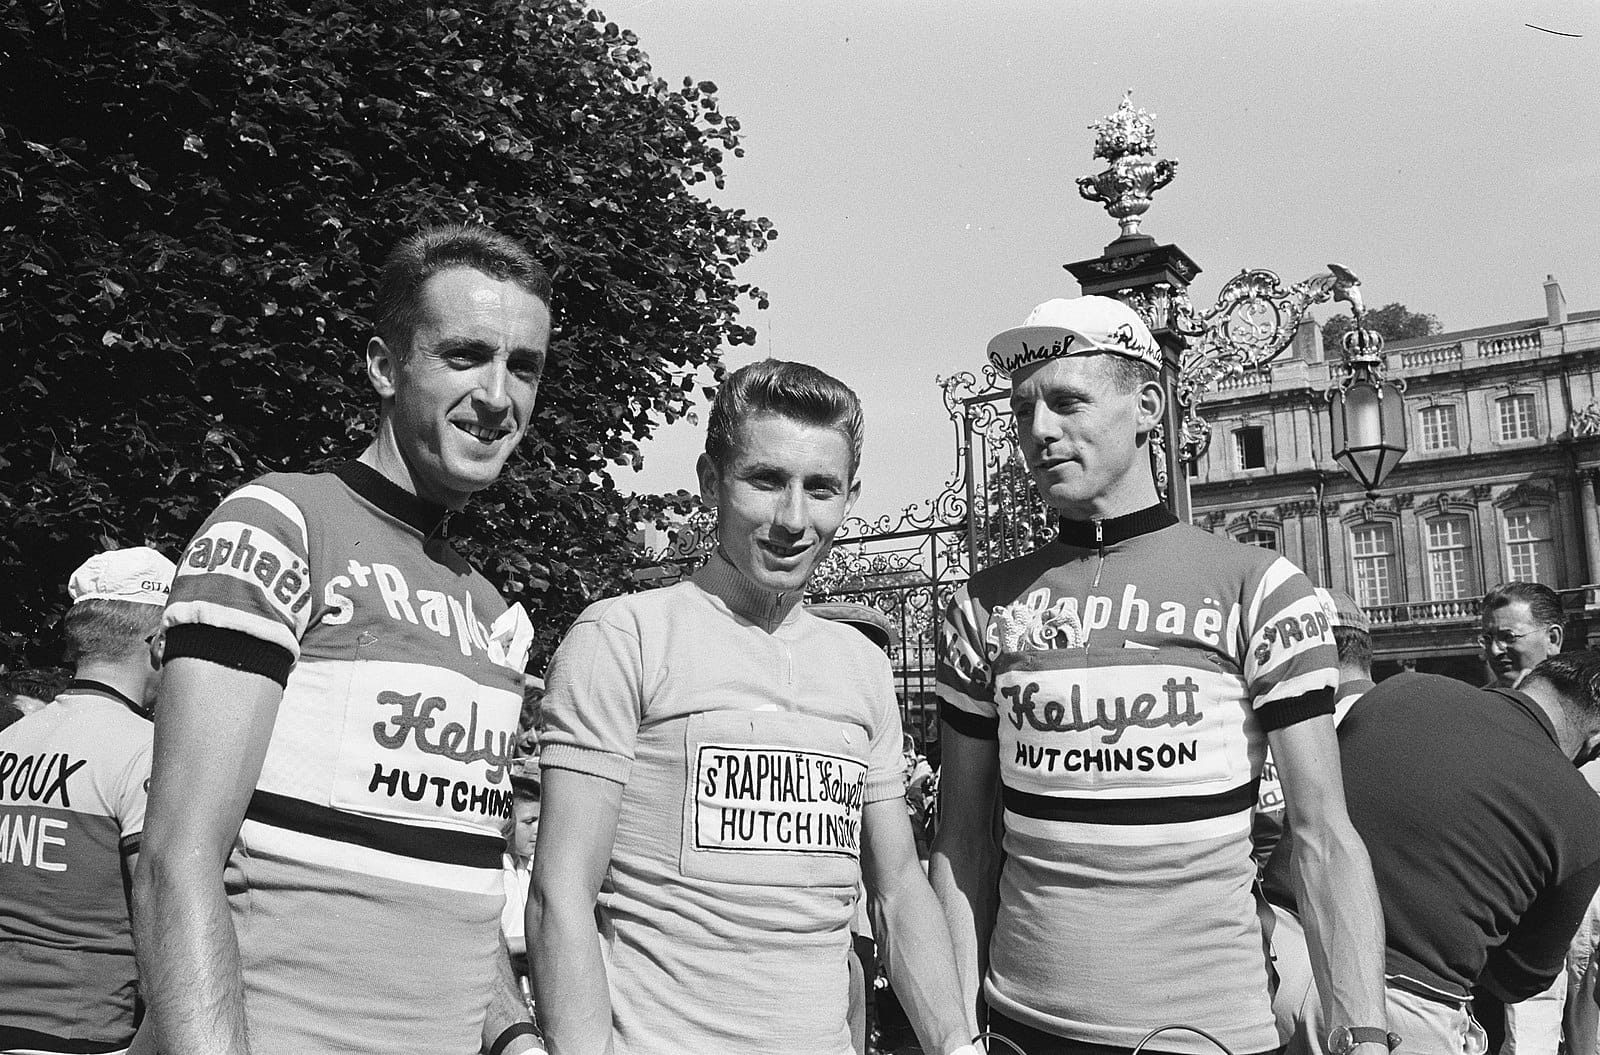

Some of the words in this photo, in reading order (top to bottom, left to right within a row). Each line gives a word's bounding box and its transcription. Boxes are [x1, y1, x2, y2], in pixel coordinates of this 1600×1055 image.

[141, 580, 170, 594] GITA
[188, 528, 312, 614] aphaël
[371, 562, 491, 657] Raph
[1275, 610, 1329, 649] Rap
[372, 690, 517, 785] Hely
[1000, 676, 1203, 744] Helyett
[0, 750, 87, 808] ROUX
[725, 753, 818, 803] RAPHAËL
[816, 760, 864, 816] Helyett
[1015, 739, 1198, 772] HUTCHINSON
[368, 763, 514, 820] HUTCHINS
[0, 814, 68, 871] ANE
